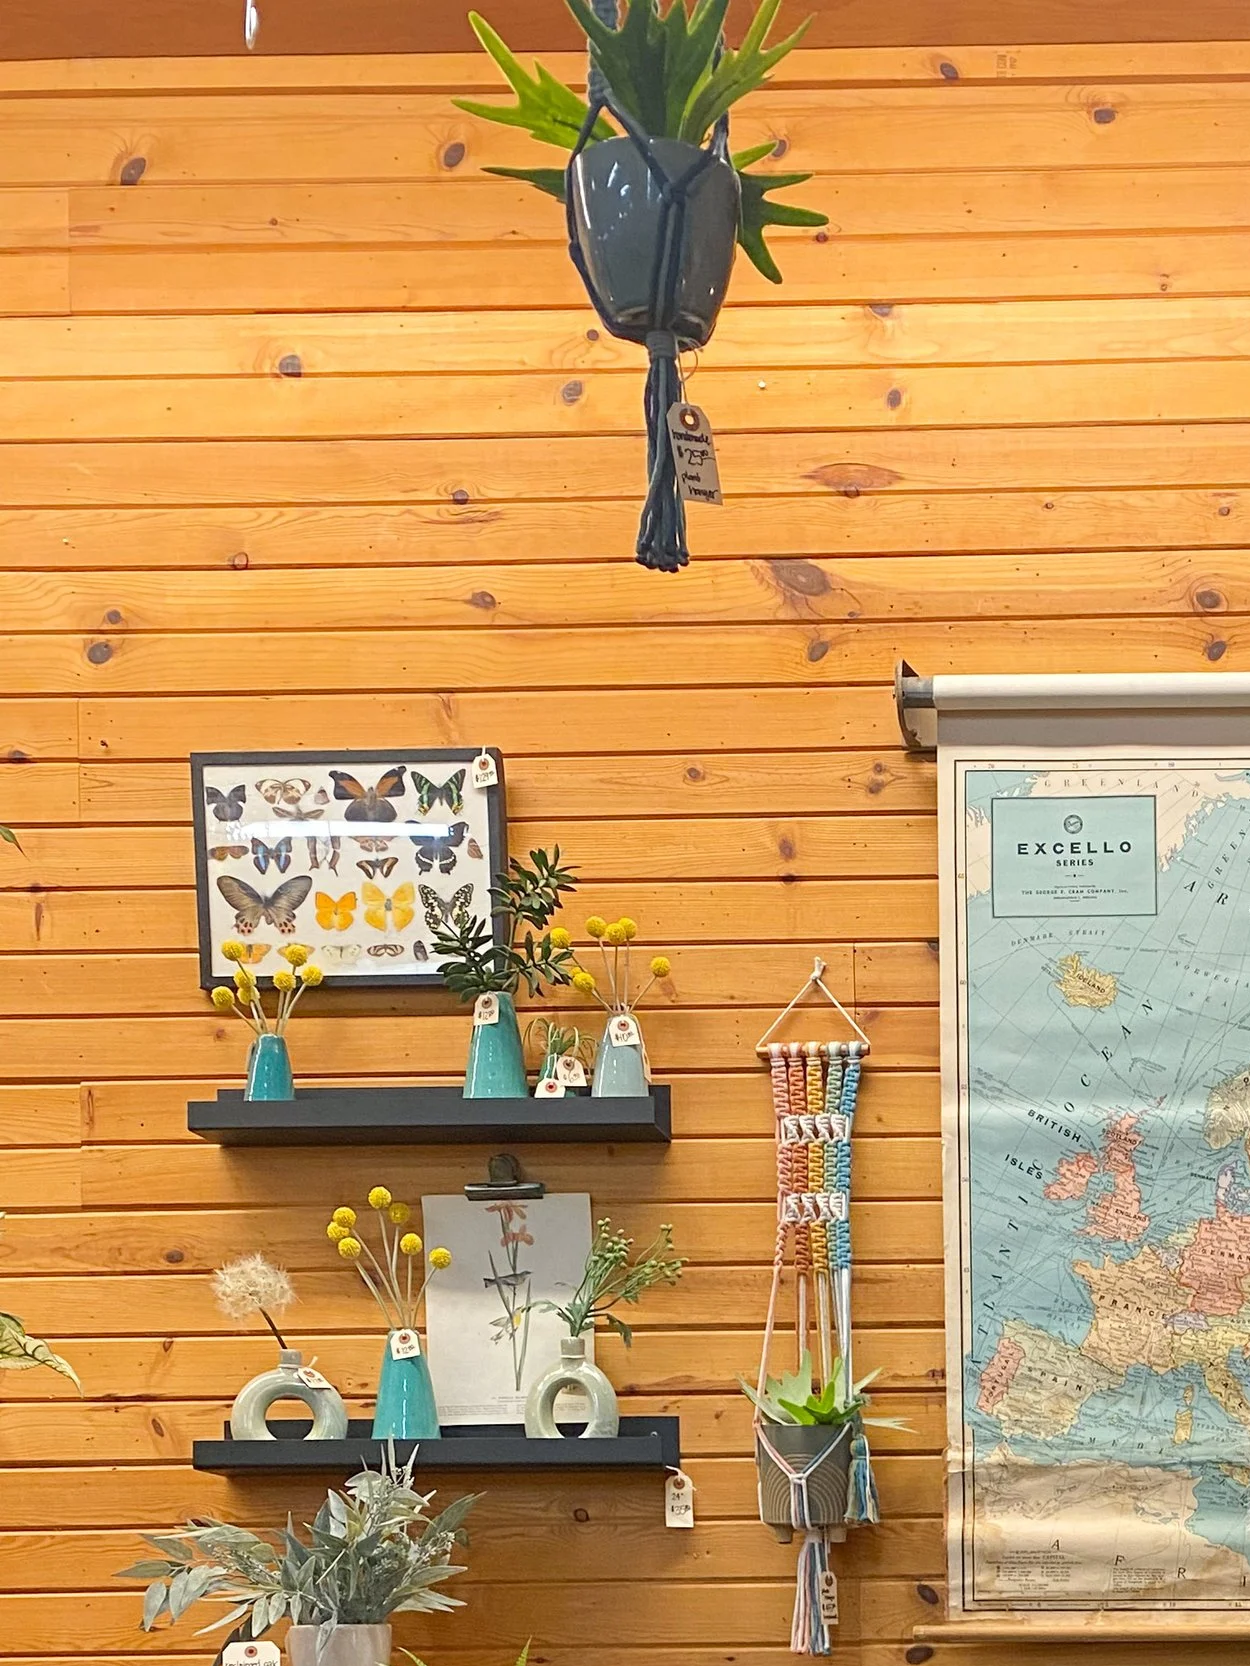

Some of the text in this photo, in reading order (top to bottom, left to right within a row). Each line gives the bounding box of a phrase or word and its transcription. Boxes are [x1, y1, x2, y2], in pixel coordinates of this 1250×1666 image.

[1044, 778, 1199, 797] GREENLAND
[1017, 841, 1133, 855] EXCELLO
[1056, 859, 1094, 867] SERIES
[1010, 932, 1055, 947] DENMARK
[1075, 973, 1106, 994] ICELAND
[1189, 991, 1228, 1007] SEA
[1027, 1109, 1081, 1142] BRITISH
[1102, 1128, 1137, 1145] SCOTLAND
[1004, 1154, 1043, 1180] ISLES
[1115, 1208, 1147, 1222] ENGLAND
[1099, 1295, 1166, 1319] FRANCE
[1027, 1366, 1083, 1391] SPAIN
